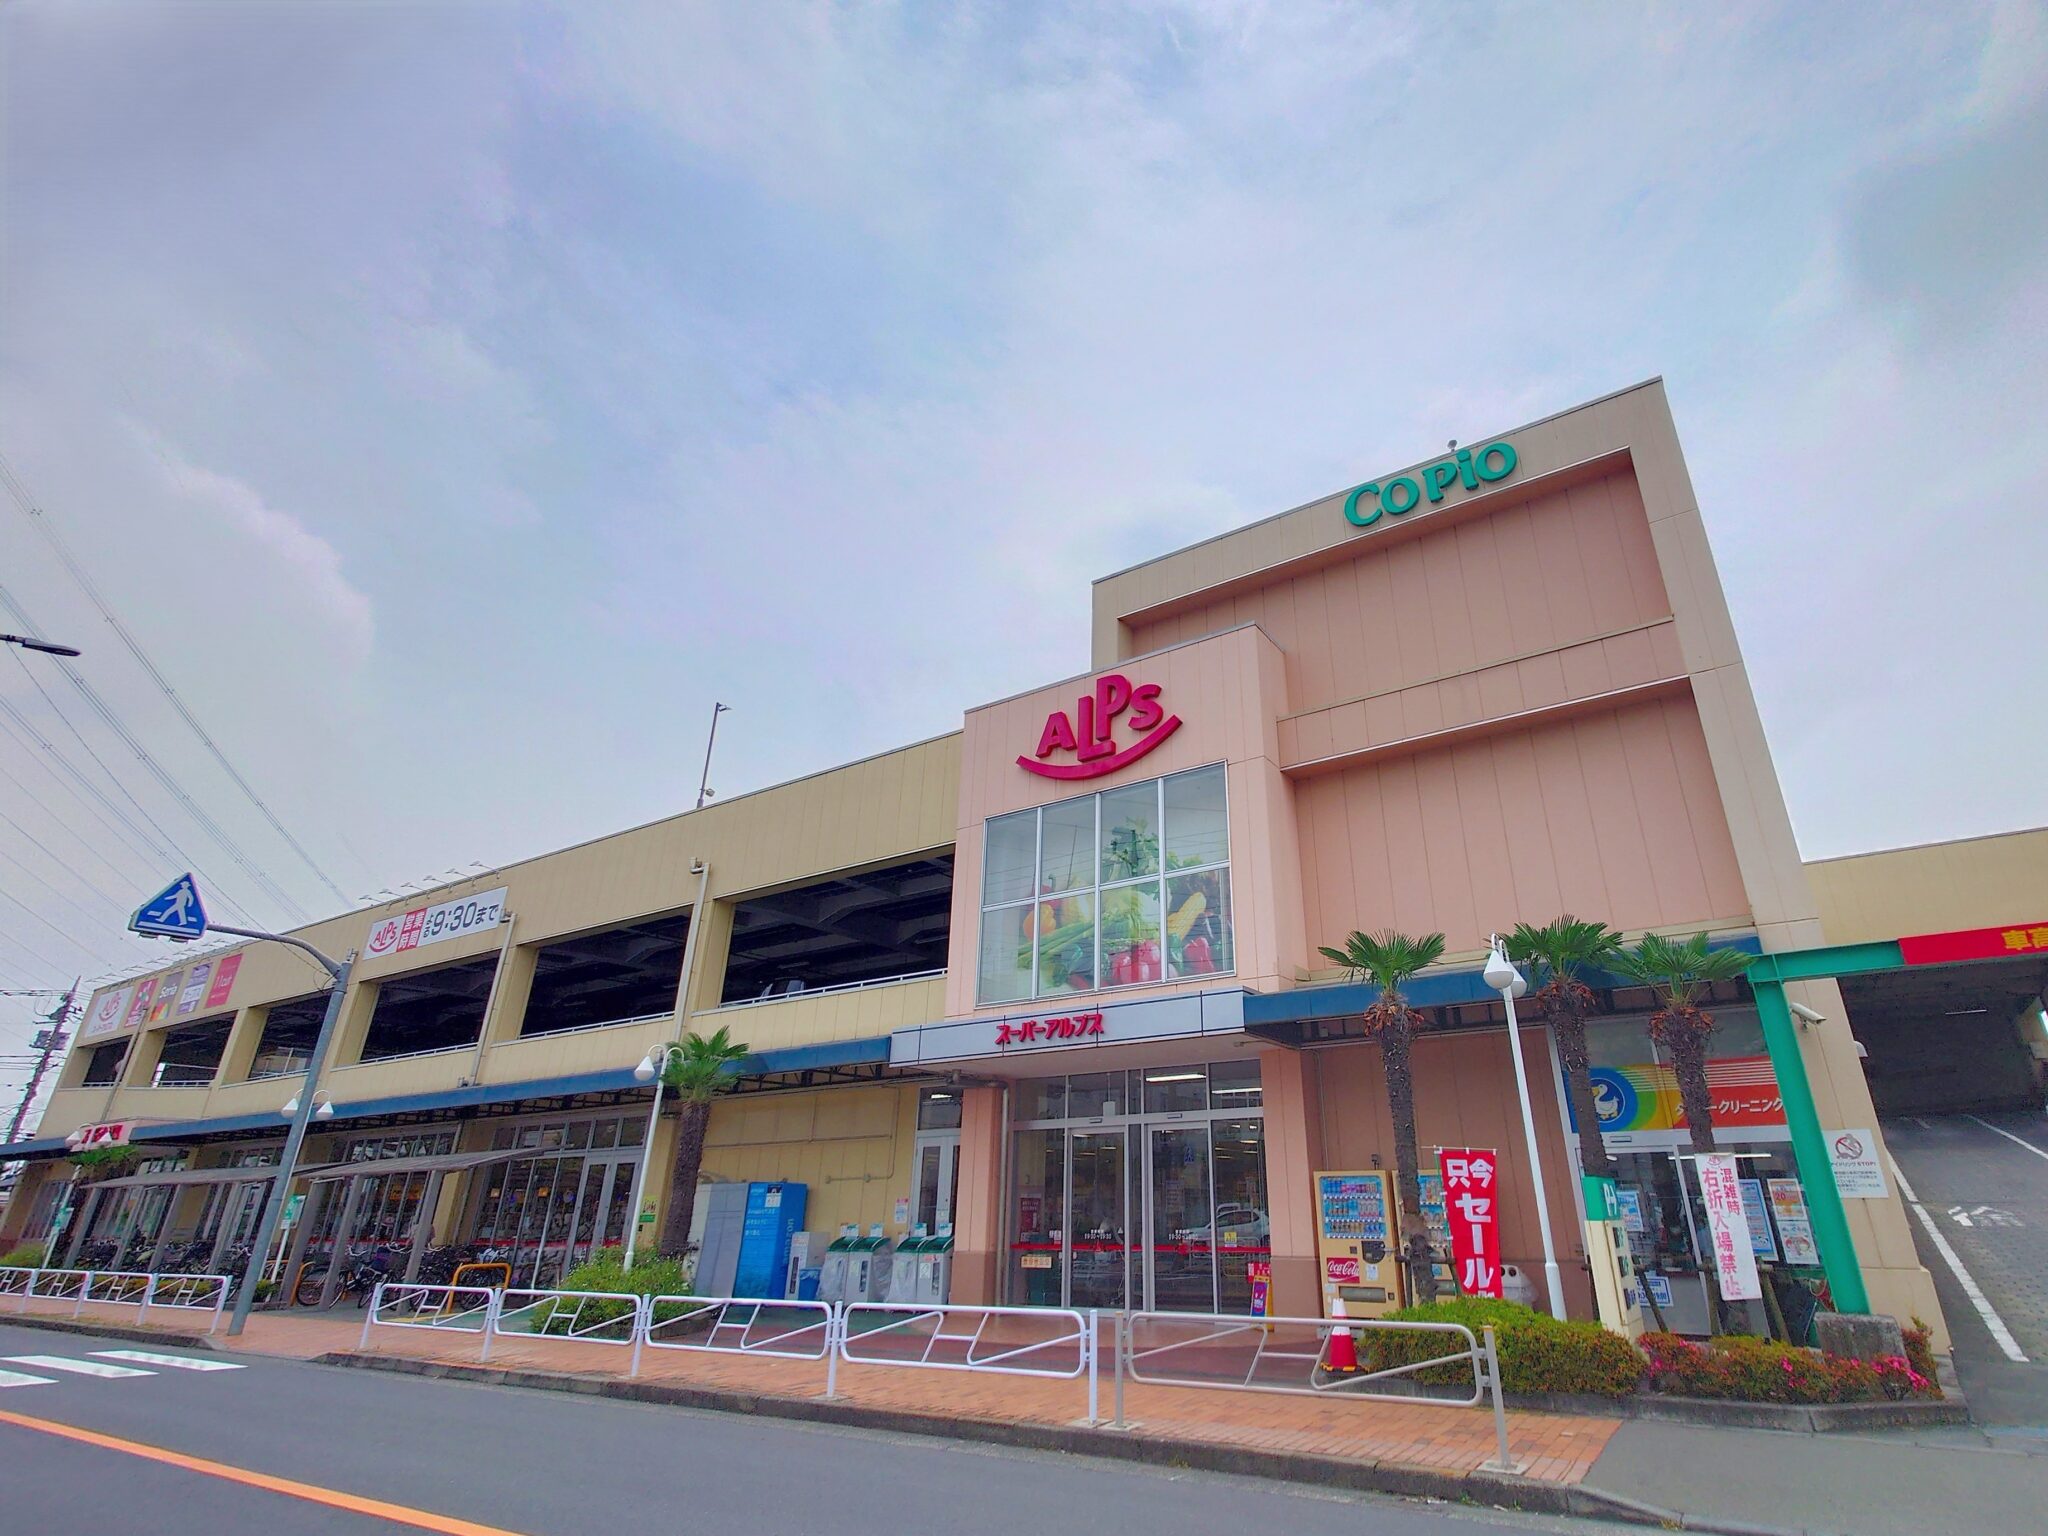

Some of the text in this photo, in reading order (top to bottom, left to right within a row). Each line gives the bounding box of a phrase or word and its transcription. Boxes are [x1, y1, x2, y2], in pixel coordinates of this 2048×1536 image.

[995, 1013, 1104, 1044] スーパーアルプス
[1675, 1097, 1784, 1117] ークリーニング
[1455, 1193, 1495, 1289] セール
